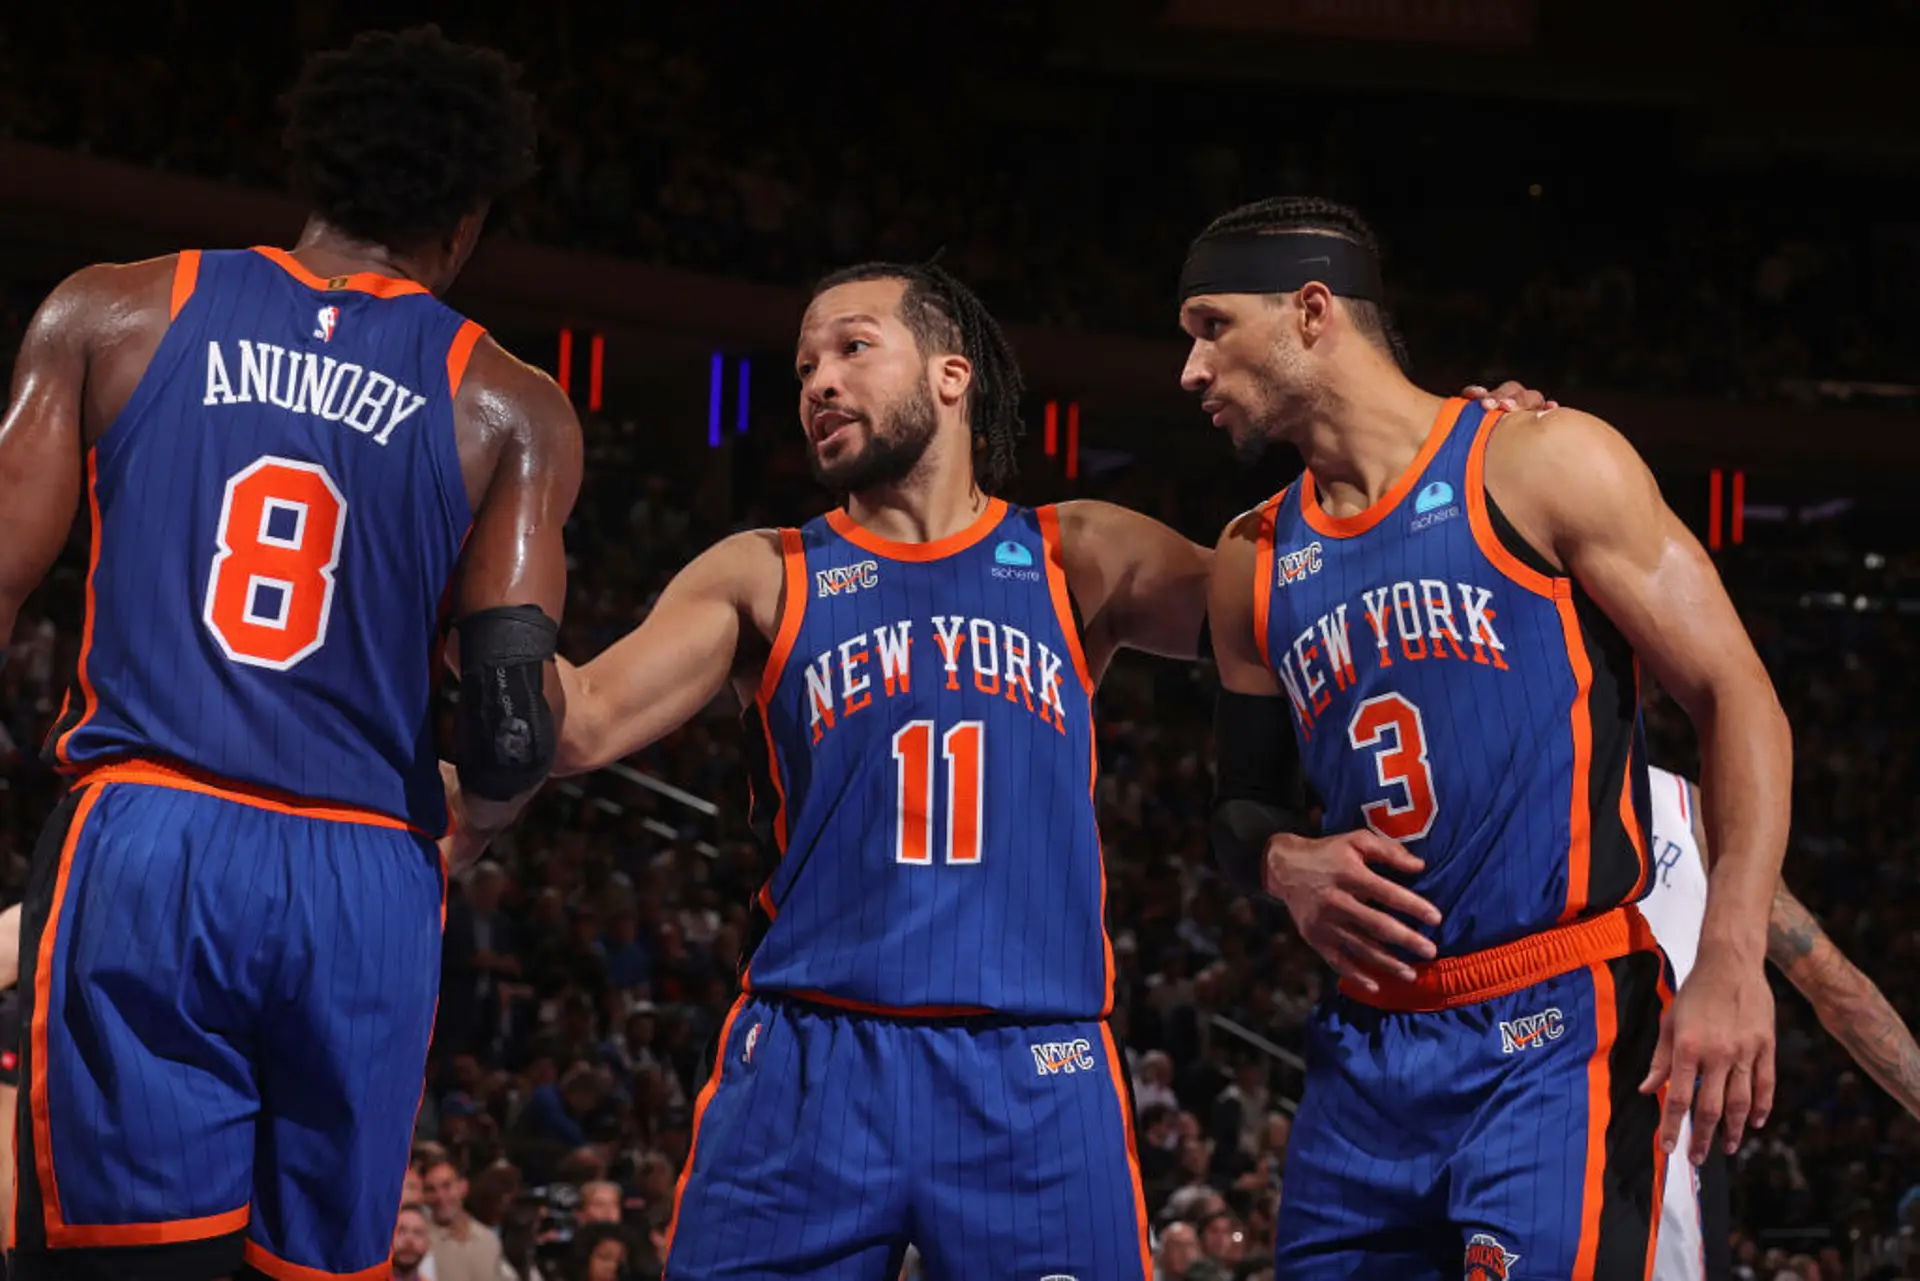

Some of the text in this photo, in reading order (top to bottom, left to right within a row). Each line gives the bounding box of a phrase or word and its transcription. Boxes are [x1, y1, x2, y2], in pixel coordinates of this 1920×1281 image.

[203, 339, 427, 446] ANUNOBY
[203, 455, 348, 671] 8
[816, 560, 879, 598] NYC
[1278, 541, 1323, 587] NYC
[804, 616, 1066, 746] NEW YORK
[1279, 579, 1509, 743] NEW YORK
[892, 719, 985, 866] 11
[1348, 691, 1439, 842] 3
[1031, 1038, 1094, 1076] NYC
[1500, 1007, 1564, 1054] NYC
